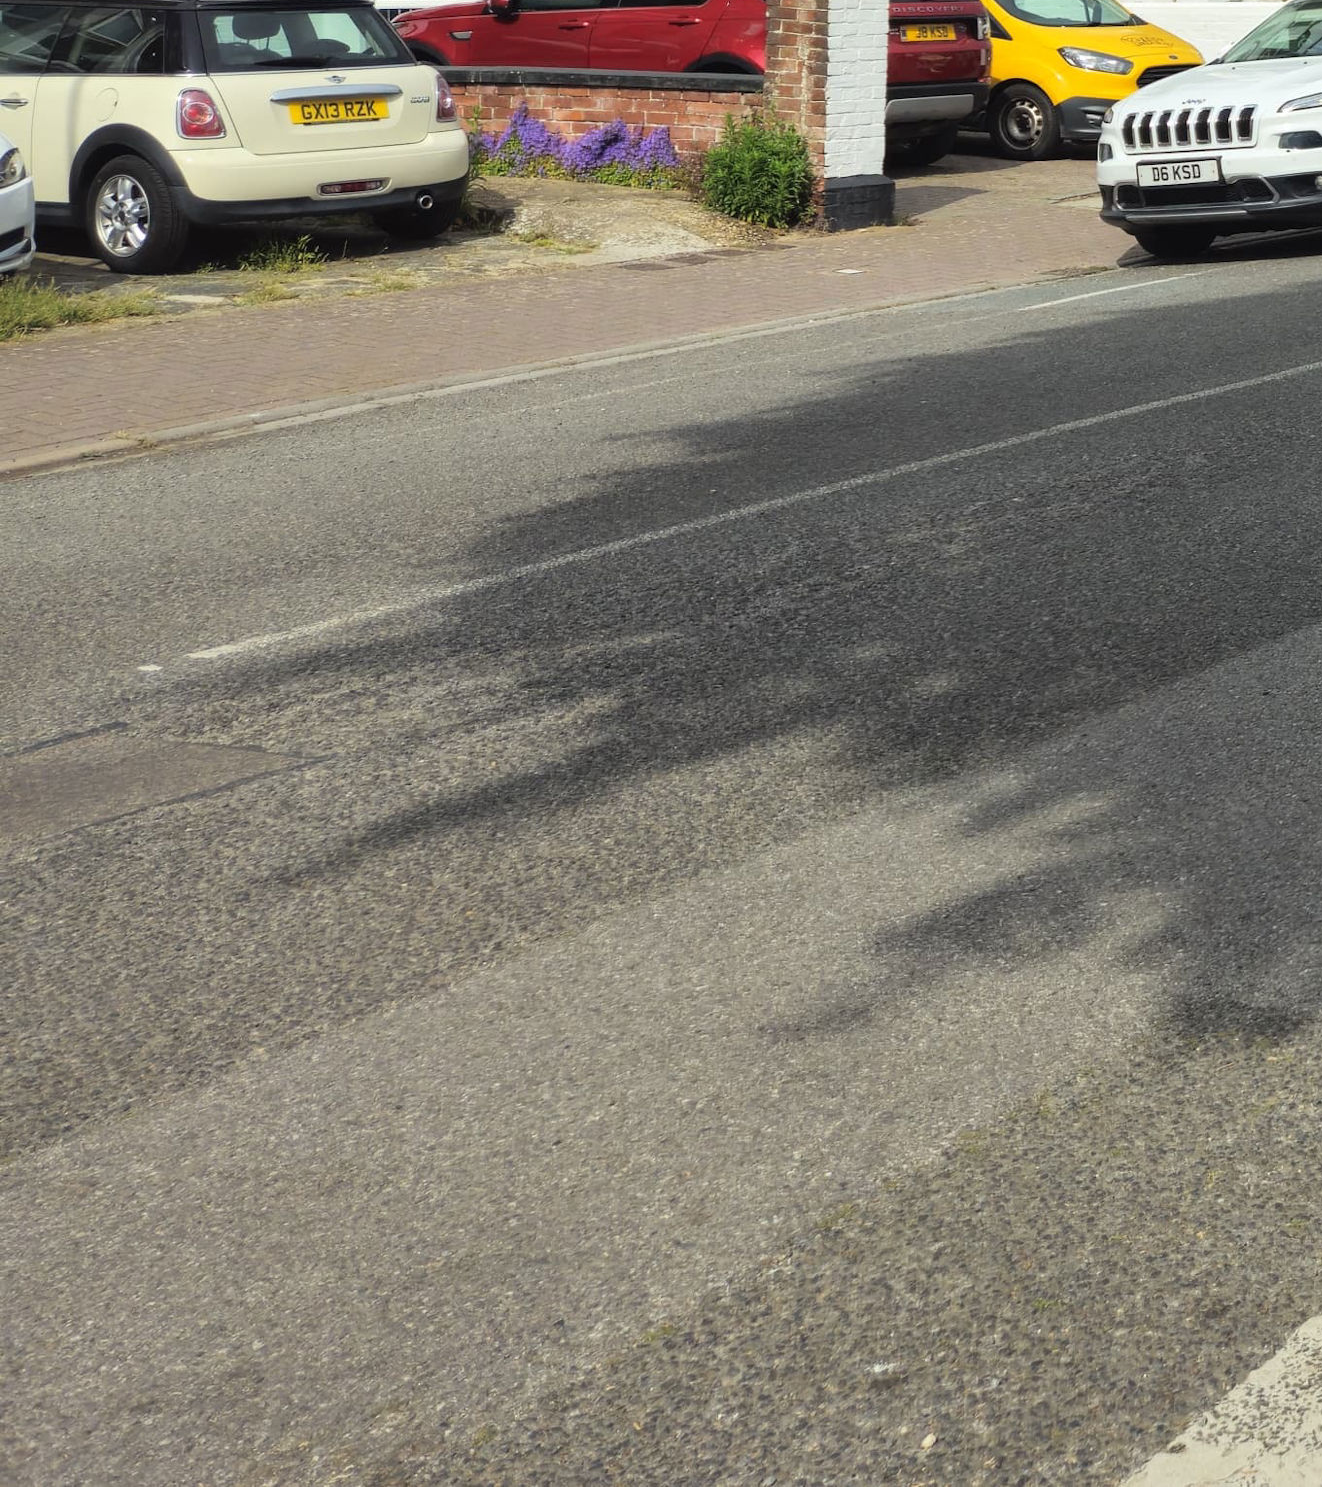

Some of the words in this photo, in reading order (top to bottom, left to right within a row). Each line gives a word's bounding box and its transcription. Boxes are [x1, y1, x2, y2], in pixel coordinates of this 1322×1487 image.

[301, 103, 340, 120] GX13
[344, 100, 377, 117] RZK
[1152, 166, 1169, 182] D6
[1172, 164, 1201, 181] KSD
